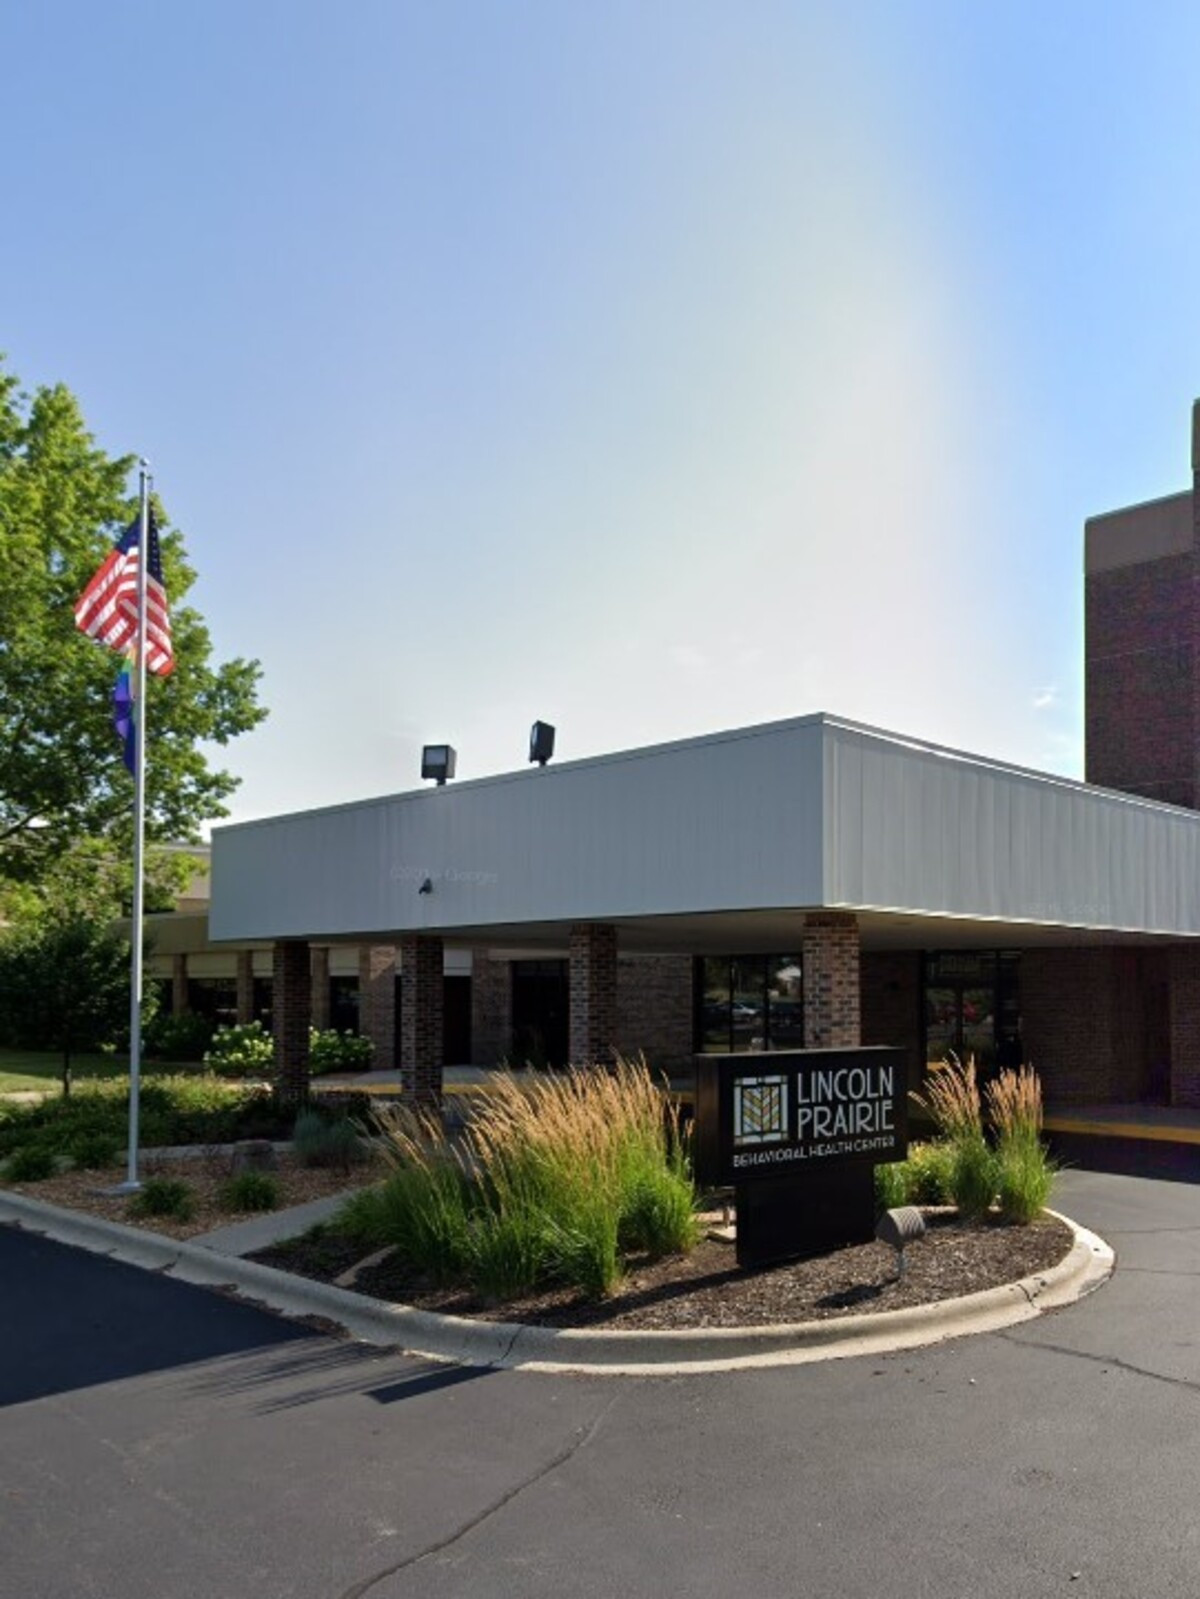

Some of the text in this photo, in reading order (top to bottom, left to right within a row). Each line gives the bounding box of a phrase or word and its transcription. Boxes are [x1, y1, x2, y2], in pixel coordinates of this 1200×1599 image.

[798, 1066, 894, 1104] LINCOLN
[798, 1100, 895, 1140] PRAIRIE
[733, 1135, 895, 1168] BEHAVIORAL HEALTH CENTER
